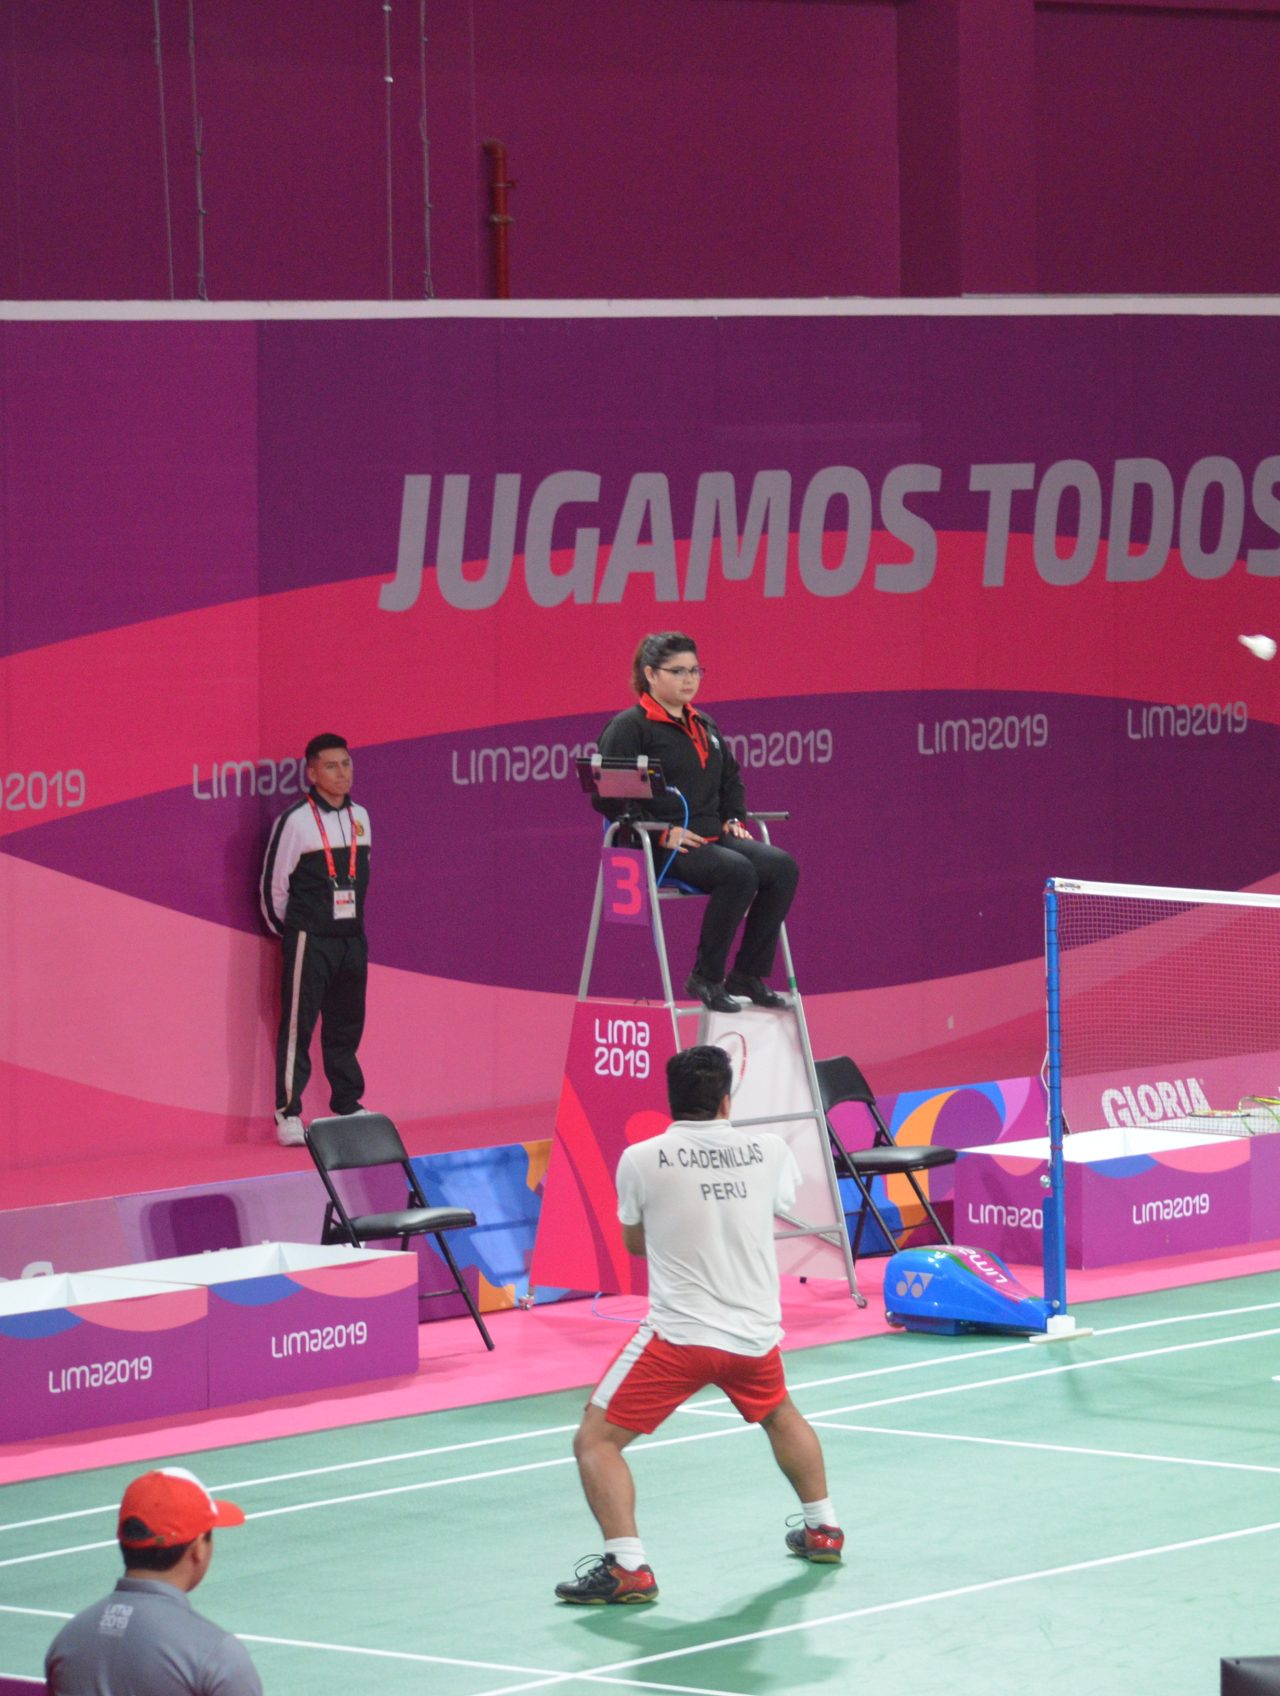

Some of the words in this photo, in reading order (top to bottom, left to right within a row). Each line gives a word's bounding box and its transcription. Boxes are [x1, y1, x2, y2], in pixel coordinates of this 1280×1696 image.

[378, 463, 942, 612] JUGAMOS
[0, 768, 86, 812] 2019
[610, 855, 644, 917] 3
[594, 1046, 651, 1080] 2019
[1101, 1077, 1212, 1128] GLORIA
[658, 1148, 674, 1168] A.
[677, 1142, 764, 1169] CADENILLAS
[700, 1181, 748, 1200] PERU
